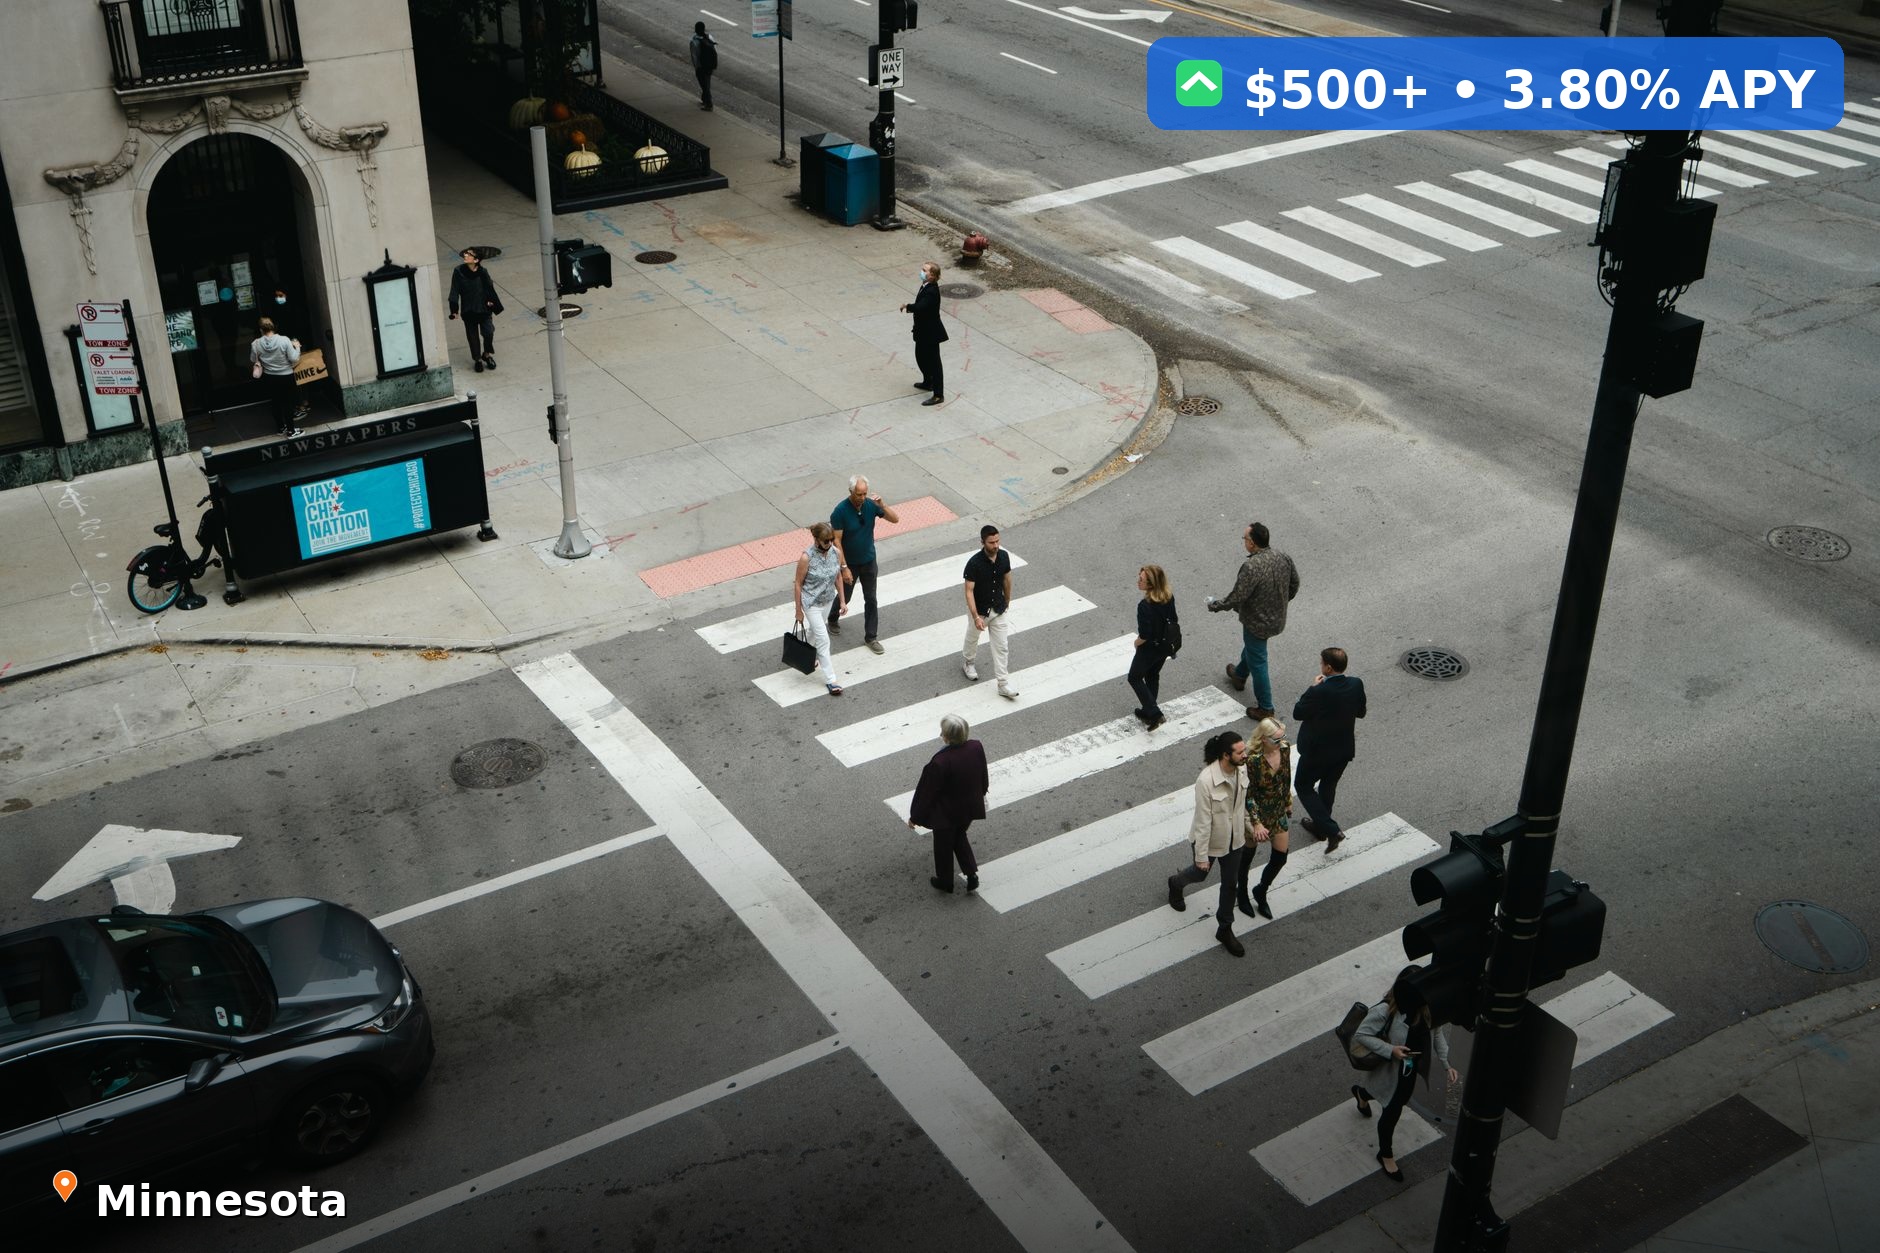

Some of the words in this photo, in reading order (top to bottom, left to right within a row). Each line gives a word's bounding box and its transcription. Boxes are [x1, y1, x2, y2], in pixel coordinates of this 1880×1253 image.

[882, 51, 901, 62] ONE
[881, 63, 901, 74] WAY
[294, 367, 316, 381] NIKE
[261, 417, 417, 461] NEWSPAPERS
[304, 482, 335, 504] VAX
[405, 460, 425, 529] #PROTECTCHICAGO
[309, 511, 368, 540] NATION
[327, 535, 338, 543] THE
[338, 529, 369, 541] MOVEMENT
